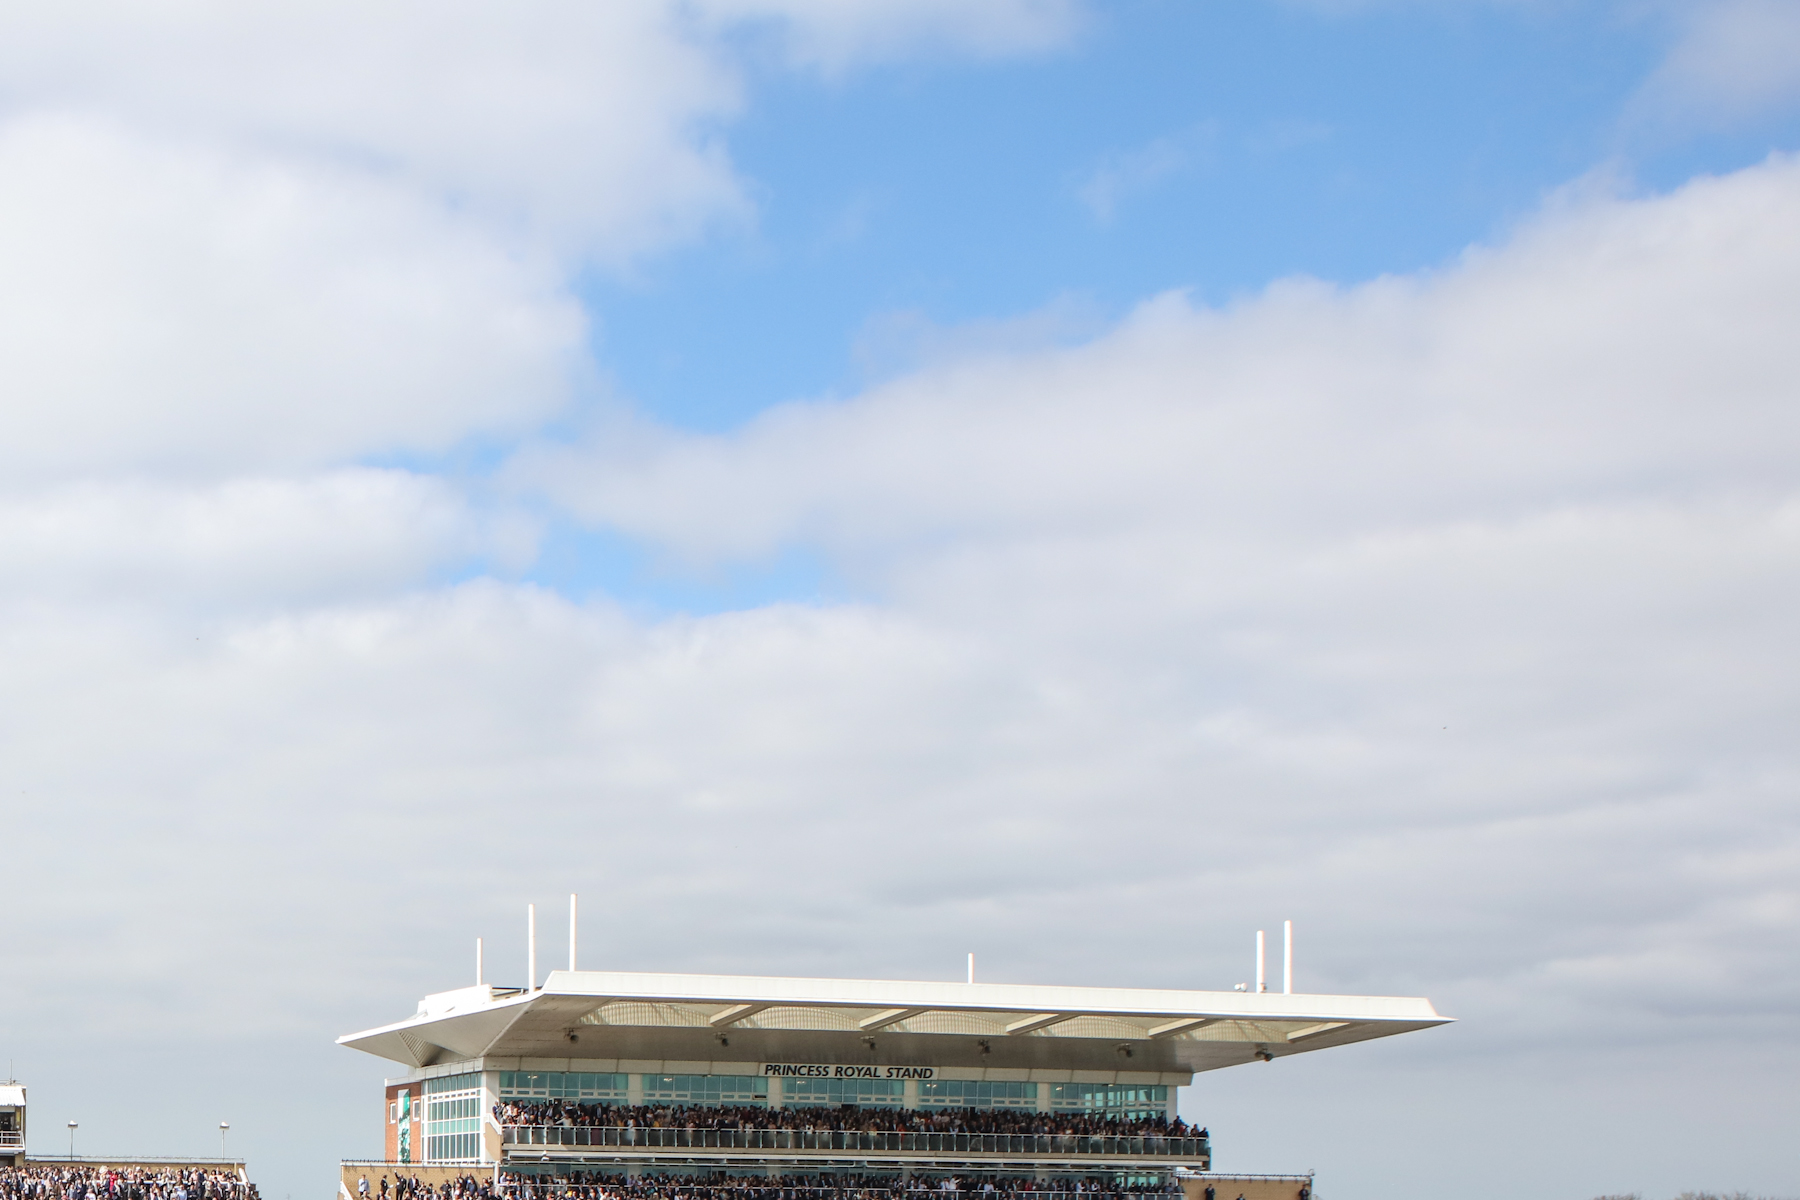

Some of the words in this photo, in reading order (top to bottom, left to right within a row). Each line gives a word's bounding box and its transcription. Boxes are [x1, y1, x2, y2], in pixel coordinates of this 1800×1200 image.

[765, 1064, 830, 1077] PRINCESS
[834, 1066, 881, 1078] ROYAL
[886, 1067, 933, 1079] STAND
